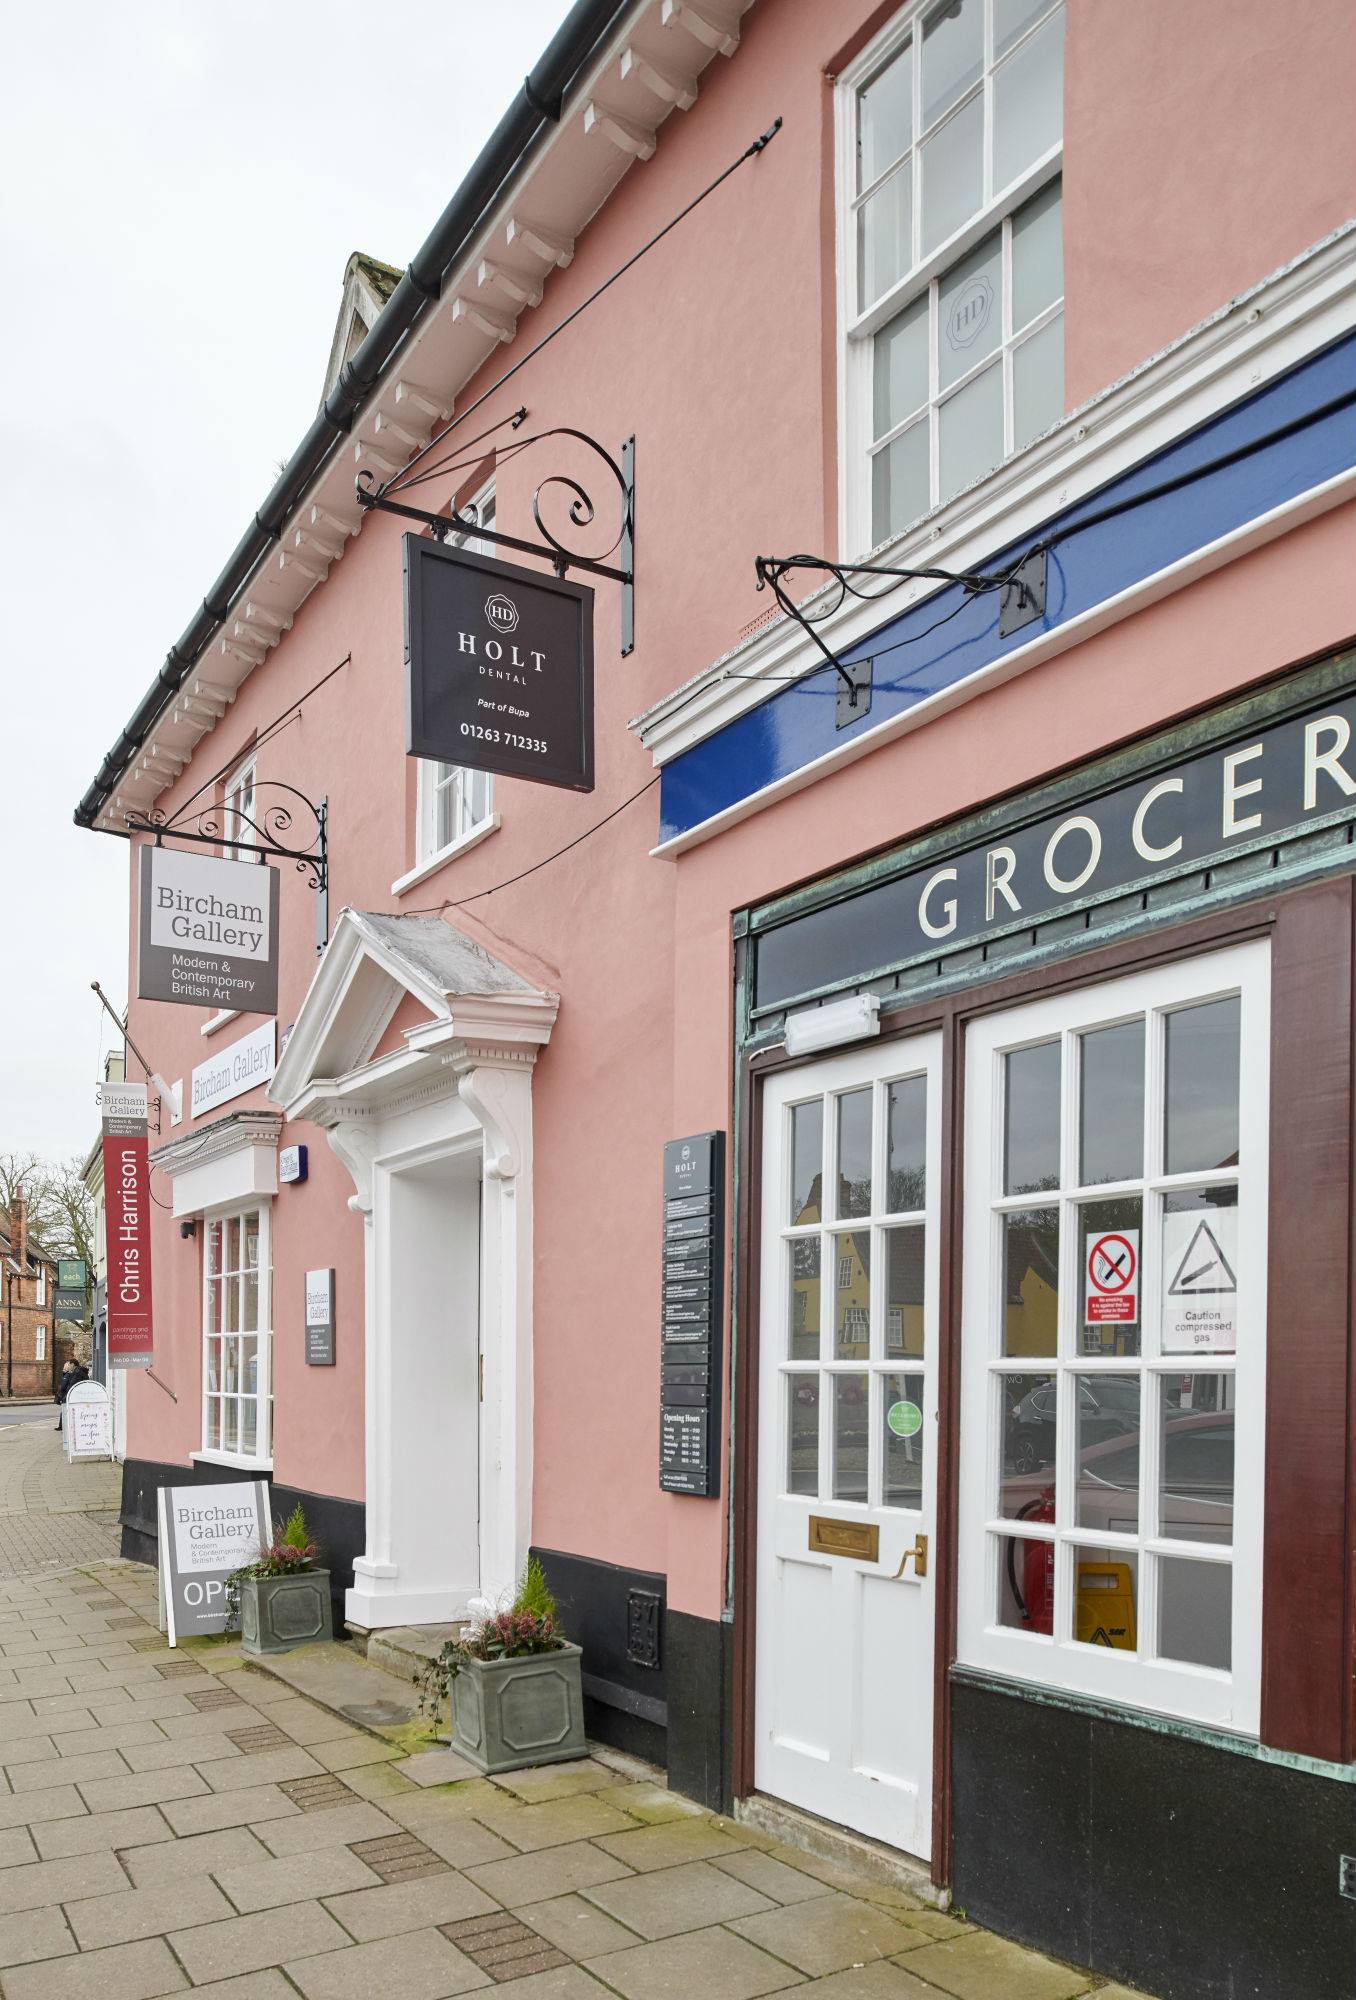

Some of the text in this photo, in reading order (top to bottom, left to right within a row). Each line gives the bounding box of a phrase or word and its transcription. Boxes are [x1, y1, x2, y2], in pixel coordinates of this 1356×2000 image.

[957, 295, 985, 332] HD
[492, 605, 513, 621] HD
[457, 631, 546, 672] HOLT
[479, 666, 527, 685] DENTAL
[477, 698, 530, 718] Part of Bupa
[460, 723, 548, 753] 01263 712335
[918, 715, 1356, 939] GROCER
[157, 886, 263, 923] Bircham
[171, 915, 263, 952] Gallery
[172, 954, 231, 972] Modern &
[172, 968, 255, 991] Contemporary
[172, 982, 231, 1000] British Art
[194, 1044, 271, 1104] Bircham Gallery
[104, 1095, 145, 1105] Bircham
[110, 1105, 145, 1116] Gallery
[675, 1161, 696, 1173] HOLT
[117, 1150, 140, 1303] Chris Harrison
[57, 1299, 82, 1307] ANNA
[1185, 1311, 1221, 1321] Caution
[1175, 1322, 1232, 1334] compressed
[1194, 1334, 1210, 1344] gas
[664, 1413, 700, 1423] Opening Hours
[178, 1506, 253, 1523] Bircham
[190, 1523, 254, 1540] Gallery
[192, 1557, 214, 1565] British
[199, 1547, 246, 1557] Contemporary
[183, 1580, 241, 1606] OPE
